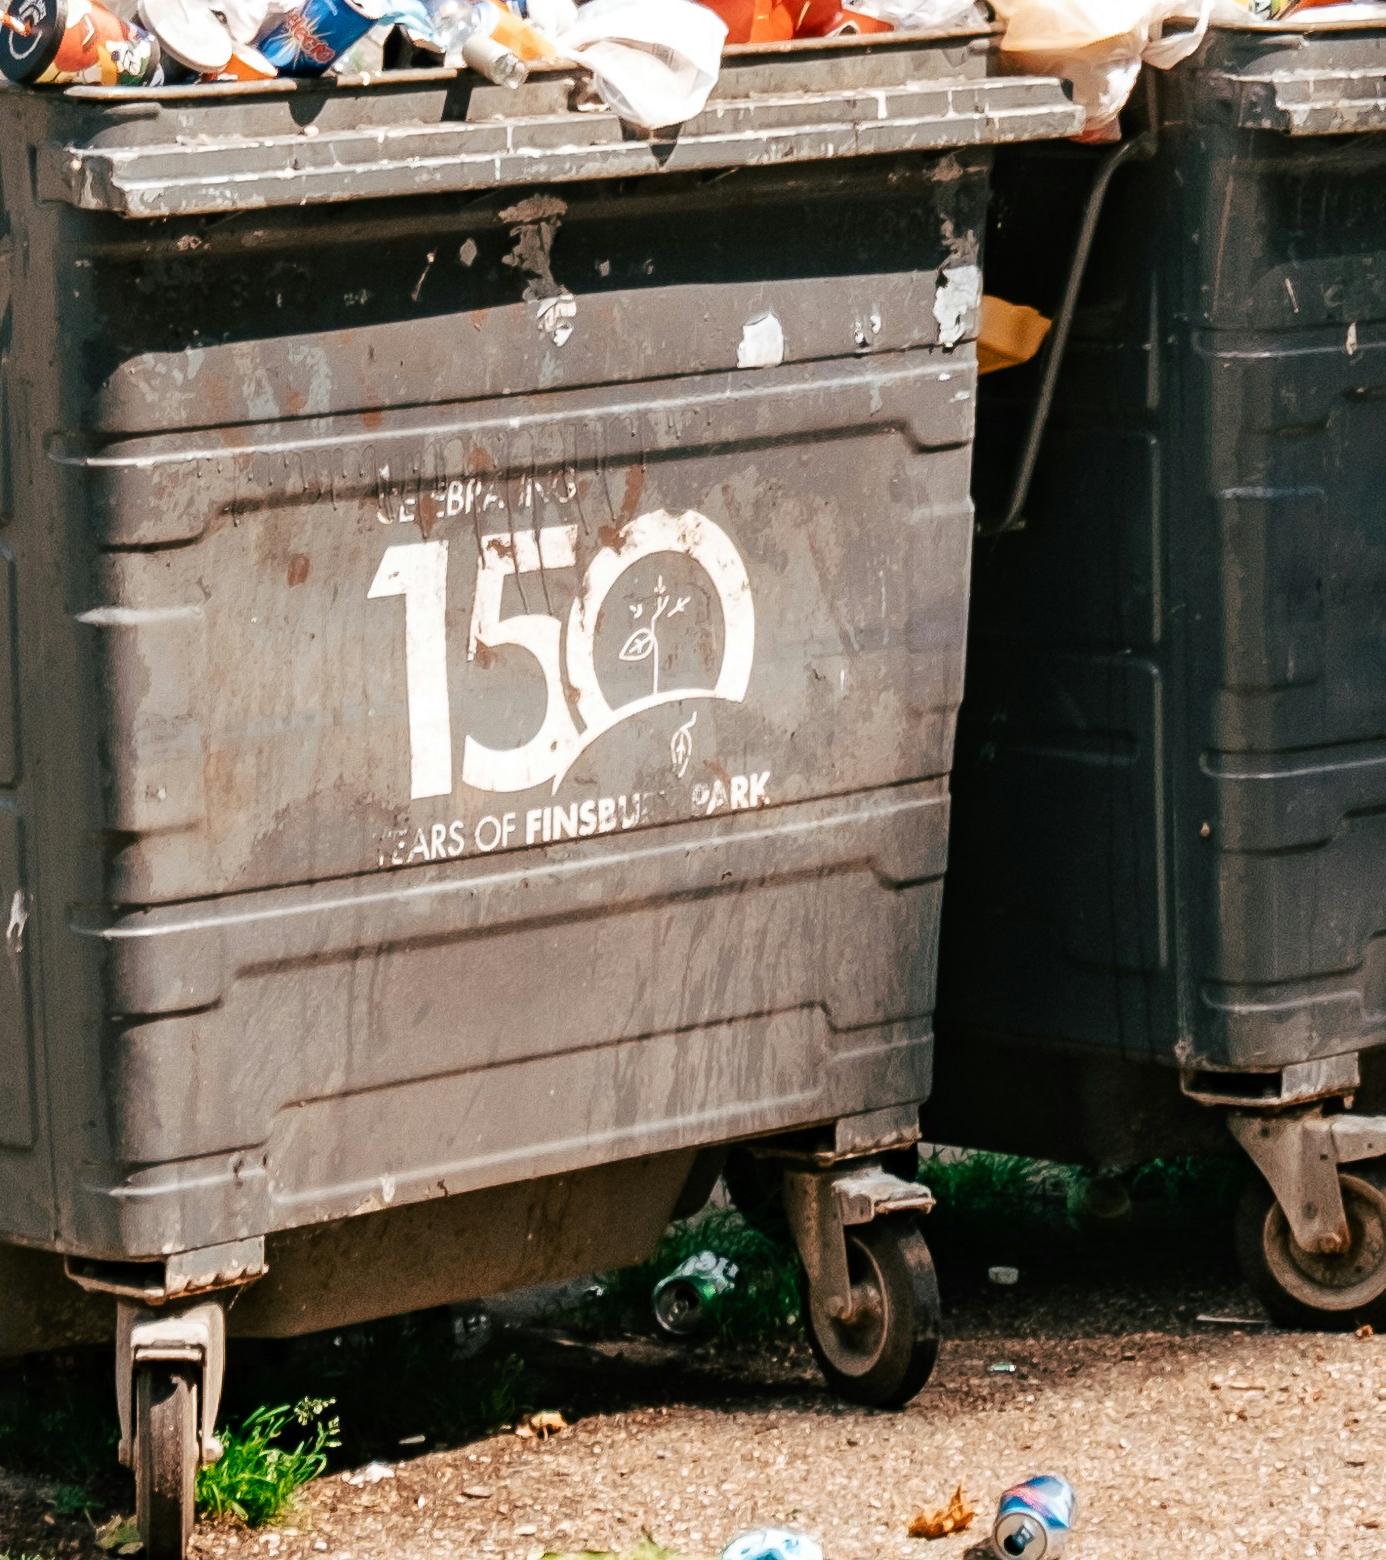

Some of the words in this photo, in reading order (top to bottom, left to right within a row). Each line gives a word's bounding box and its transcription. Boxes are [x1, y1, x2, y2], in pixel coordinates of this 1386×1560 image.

[367, 509, 755, 800] 150
[474, 811, 517, 853] OF
[691, 771, 772, 816] PARK
